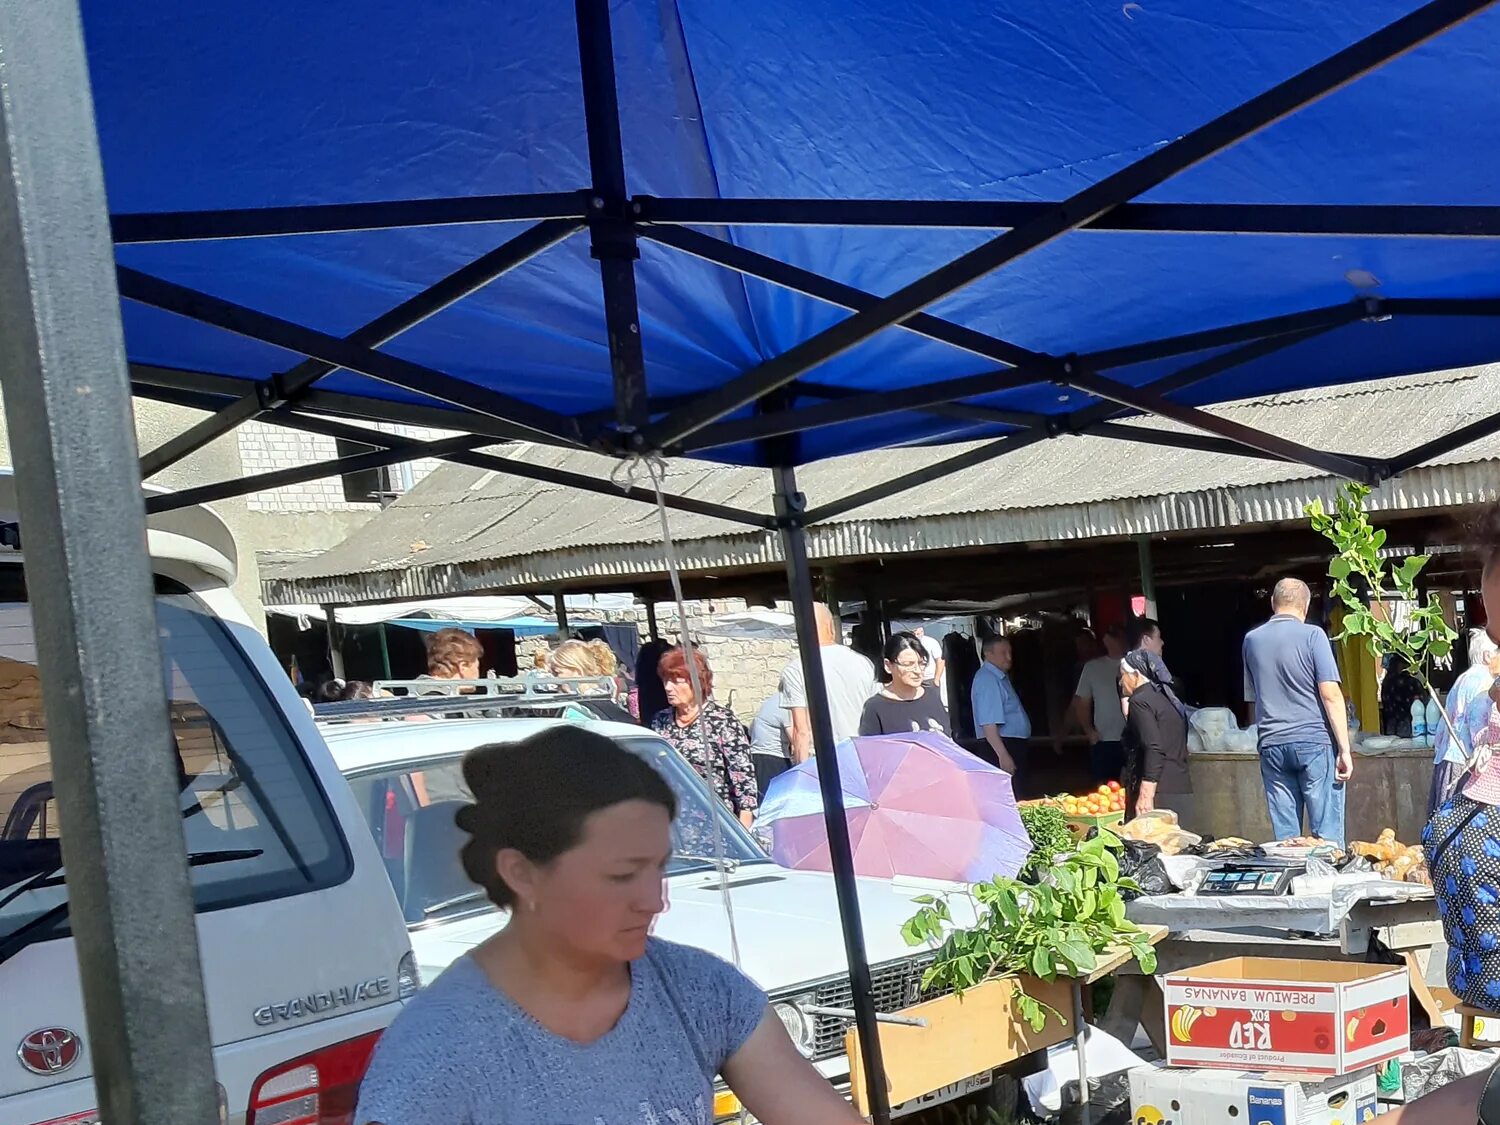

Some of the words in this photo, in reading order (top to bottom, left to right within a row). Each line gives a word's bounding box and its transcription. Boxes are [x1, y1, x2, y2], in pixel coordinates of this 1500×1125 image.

[1184, 988, 1247, 1002] BANANAS
[1254, 991, 1316, 1005] PREMIUM
[1250, 1009, 1270, 1022] BOX
[1228, 1021, 1273, 1050] RED
[1219, 1052, 1248, 1062] Ecuador
[1248, 1053, 1257, 1061] of
[1257, 1053, 1285, 1062] Product
[1249, 1095, 1283, 1106] Bananas
